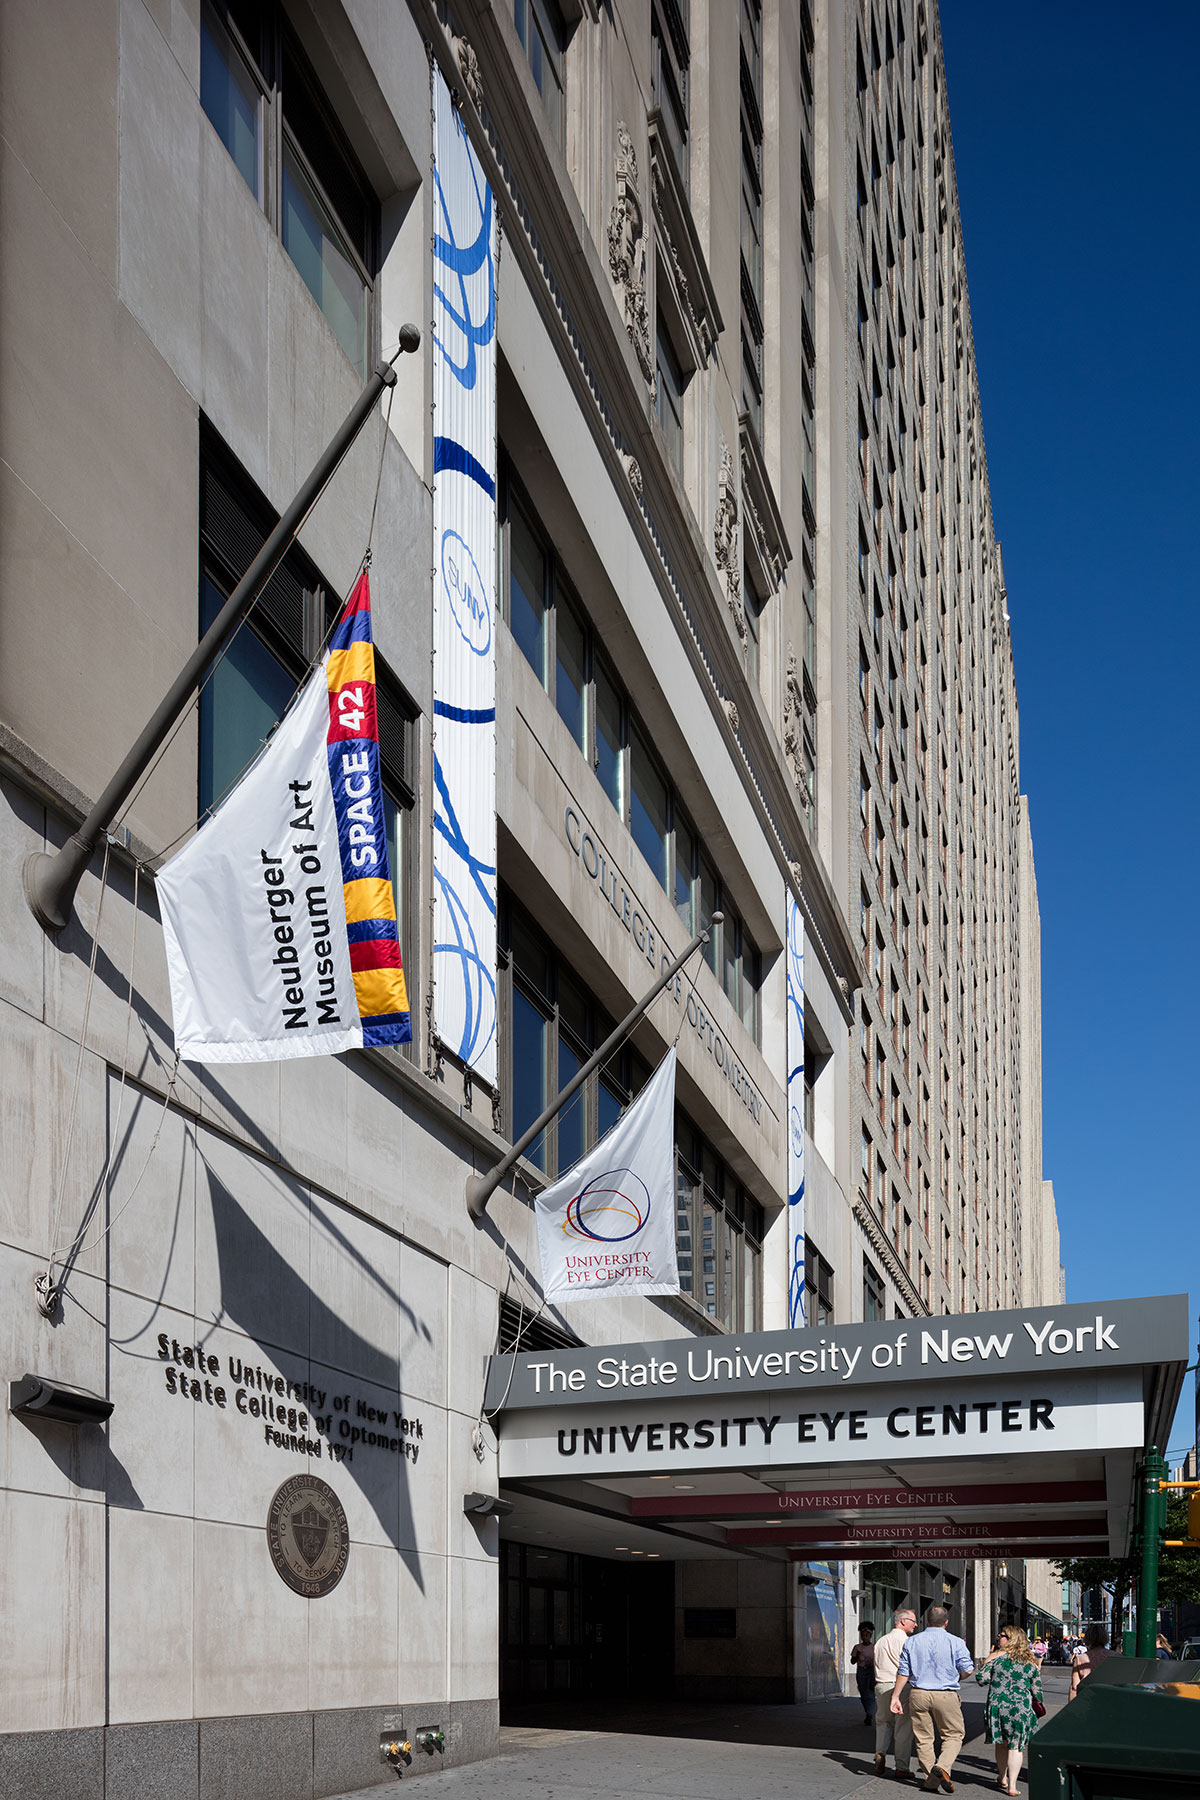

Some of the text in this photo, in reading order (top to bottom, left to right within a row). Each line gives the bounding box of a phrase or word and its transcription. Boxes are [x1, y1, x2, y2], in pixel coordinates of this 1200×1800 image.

[447, 555, 485, 629] SUNY
[338, 687, 378, 867] SPACE 42
[288, 779, 341, 1025] Museum of Art
[260, 847, 309, 1030] Neuberger
[565, 806, 763, 1126] COLLEGE OF OPTOMETRY
[565, 1251, 651, 1269] UNIVERSITY
[567, 1265, 655, 1283] EYE CENTER
[526, 1315, 1120, 1394] The State University of New York
[157, 1332, 424, 1440] State University of New York
[165, 1366, 420, 1465] State College of Optometry
[556, 1398, 1056, 1456] UNIVERSITY EYE CENTER
[264, 1424, 354, 1463] Founded 1971
[283, 1491, 304, 1518] LEARN
[316, 1494, 327, 1507] TO
[778, 1492, 958, 1508] UNIVERSITY EYE CENTER
[270, 1476, 349, 1576] STATE UNIVERSITY OF NEW YORK
[280, 1523, 287, 1538] TO
[847, 1525, 992, 1538] UNIVERSITY EYE CENTER
[292, 1560, 303, 1573] TO
[892, 1547, 1014, 1558] UNIVERSITY EYE CENTER
[301, 1581, 321, 1594] 1948
[304, 1565, 328, 1579] SERVE
